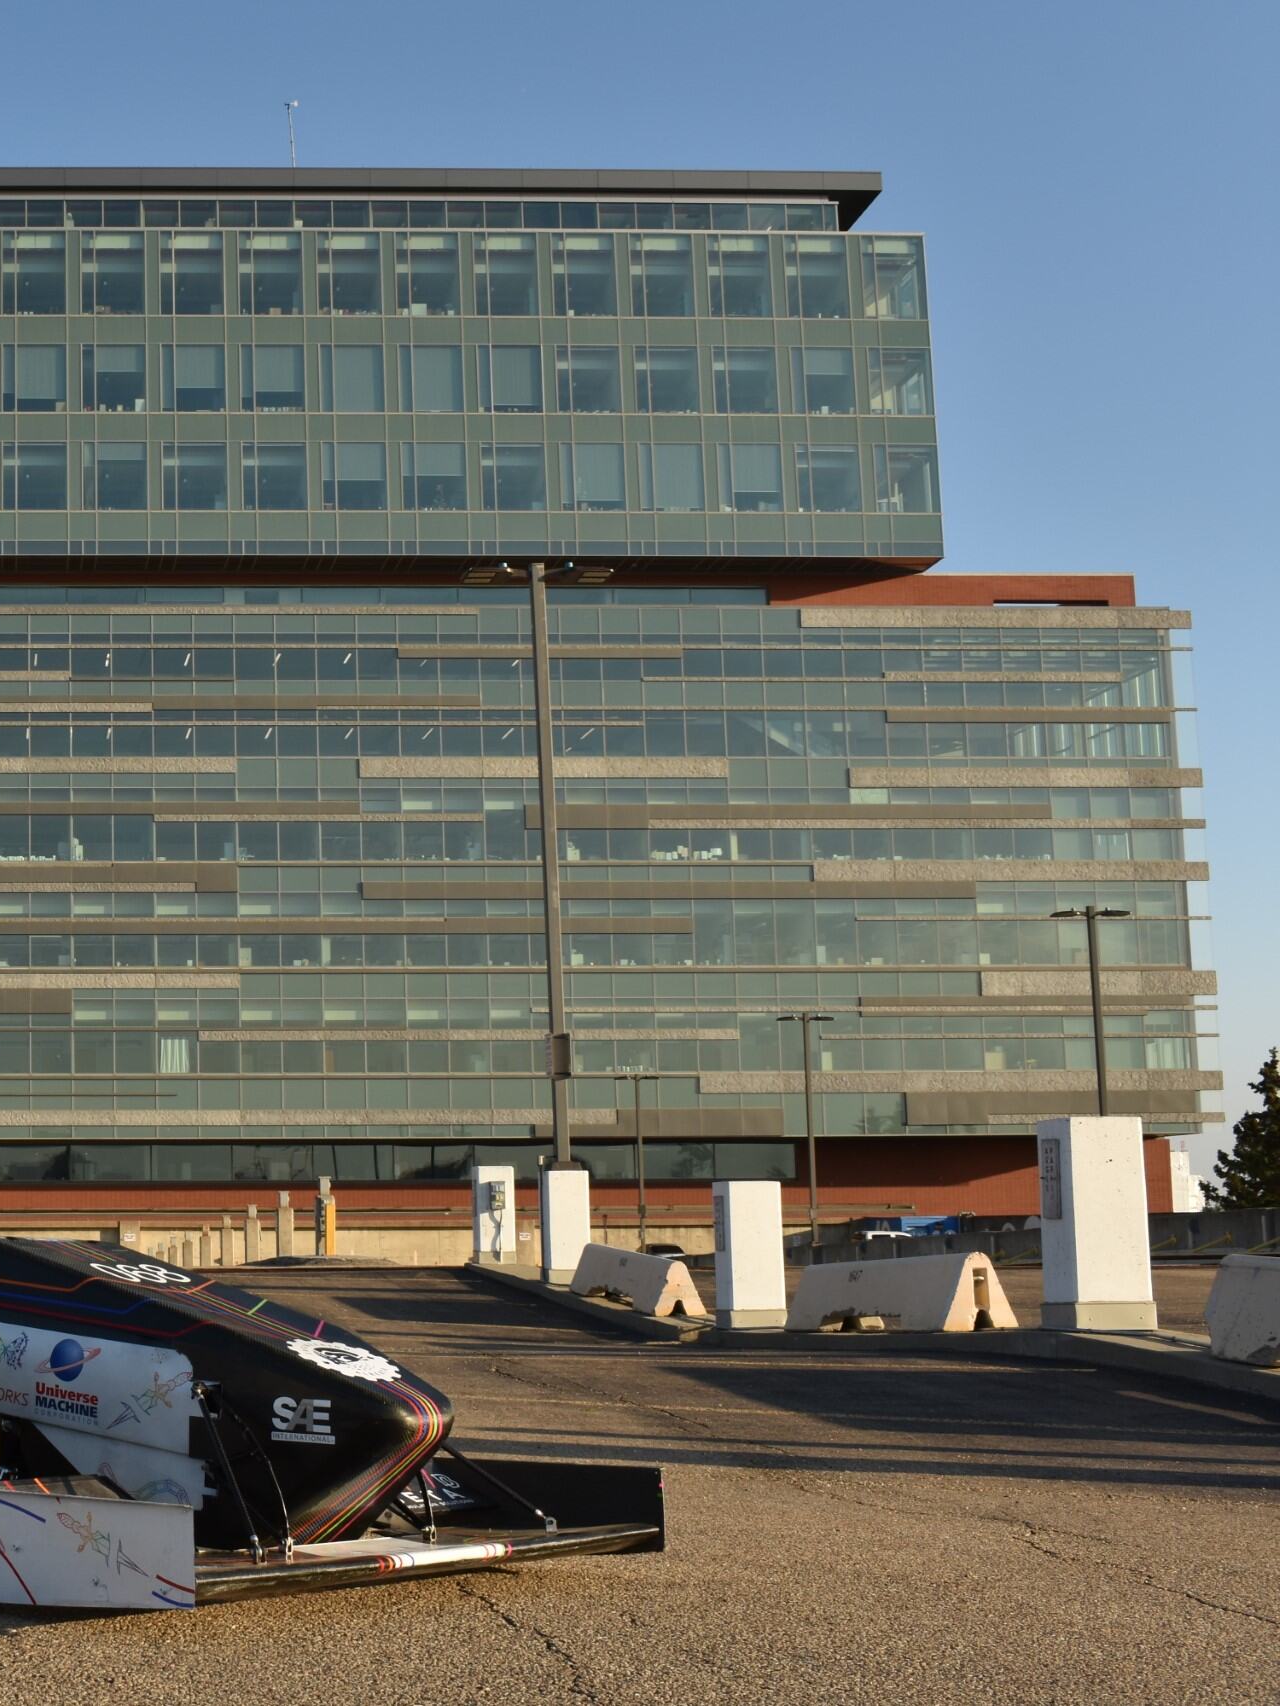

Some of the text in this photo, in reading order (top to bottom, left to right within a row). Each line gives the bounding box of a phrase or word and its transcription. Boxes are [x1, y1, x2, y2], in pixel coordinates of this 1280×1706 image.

[89, 1262, 191, 1284] 068
[35, 1381, 99, 1406] Universe
[34, 1408, 100, 1426] CORPORATION
[35, 1395, 99, 1419] MACHINE
[271, 1396, 332, 1434] SAE
